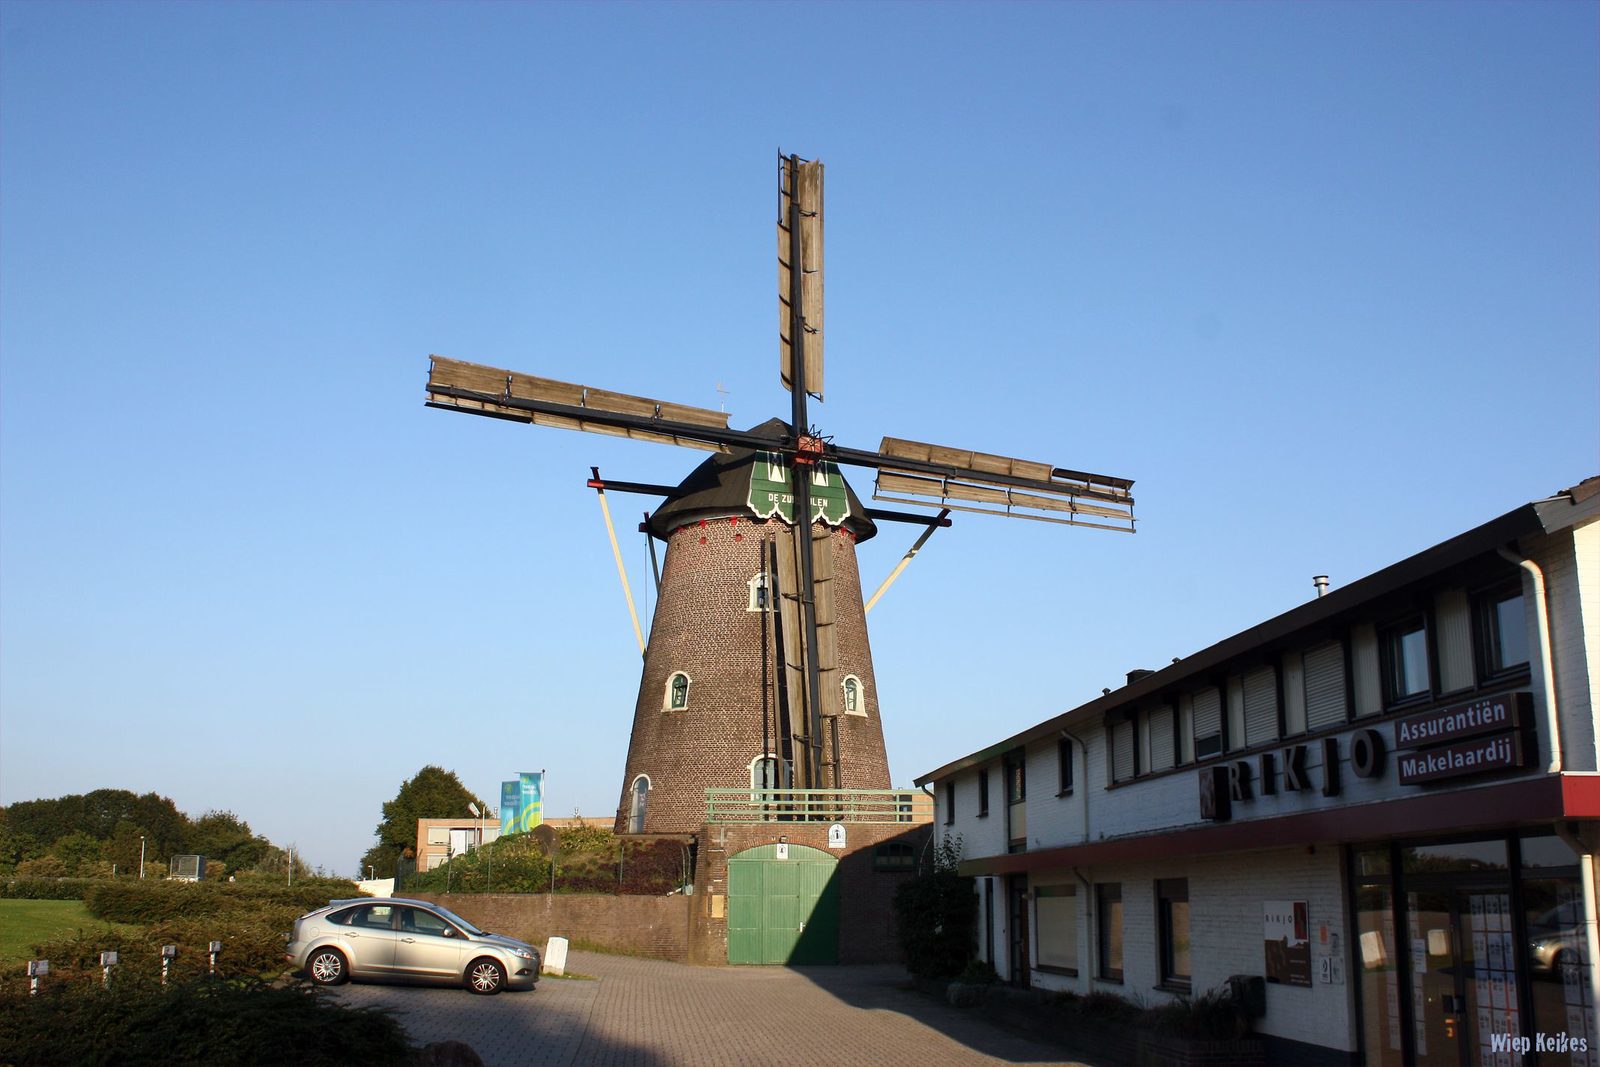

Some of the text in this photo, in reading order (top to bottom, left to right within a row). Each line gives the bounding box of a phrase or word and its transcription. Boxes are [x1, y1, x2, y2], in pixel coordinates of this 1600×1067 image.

[768, 493, 779, 502] DE
[1399, 701, 1506, 743] Assurantiën
[1227, 729, 1382, 801] RIKJO
[1402, 738, 1512, 778] Makelaardij
